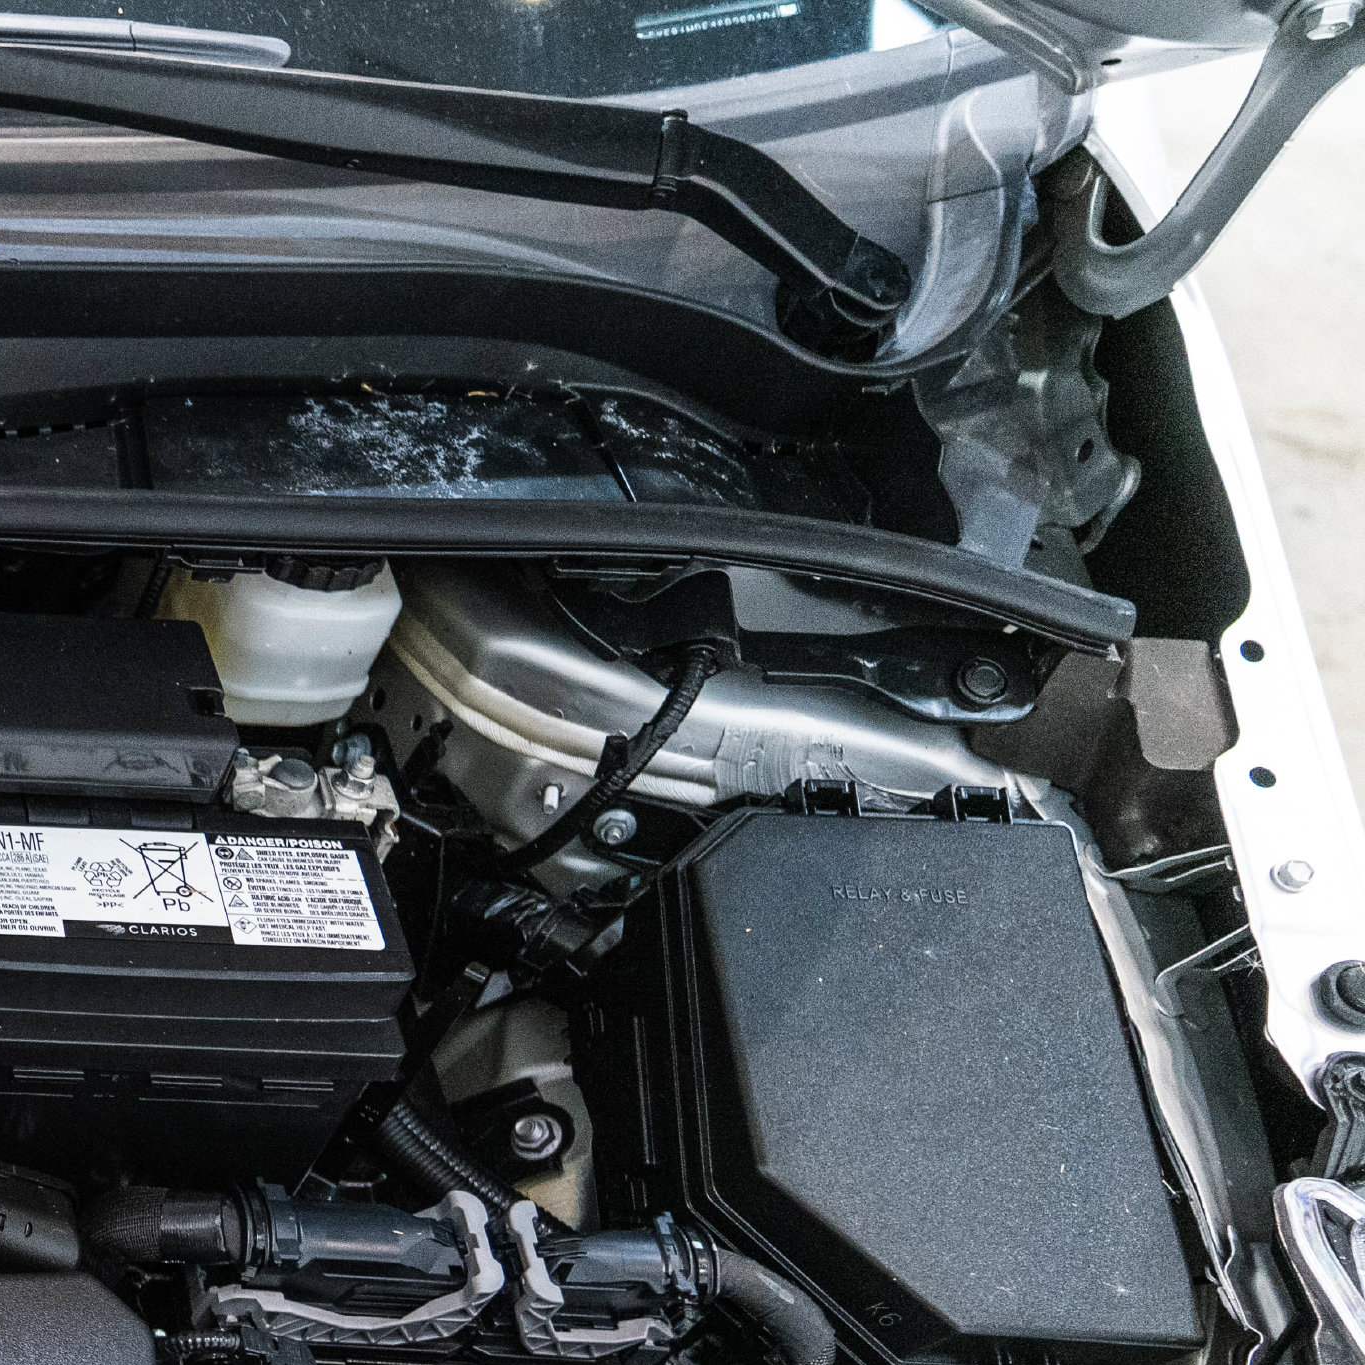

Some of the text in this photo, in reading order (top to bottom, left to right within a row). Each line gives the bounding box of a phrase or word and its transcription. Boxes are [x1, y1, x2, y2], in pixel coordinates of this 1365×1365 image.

[226, 836, 343, 850] DANGER/POISON
[831, 884, 968, 906] RELAY & FUSE
[162, 898, 191, 912] Pb
[128, 925, 198, 937] CLARIOS
